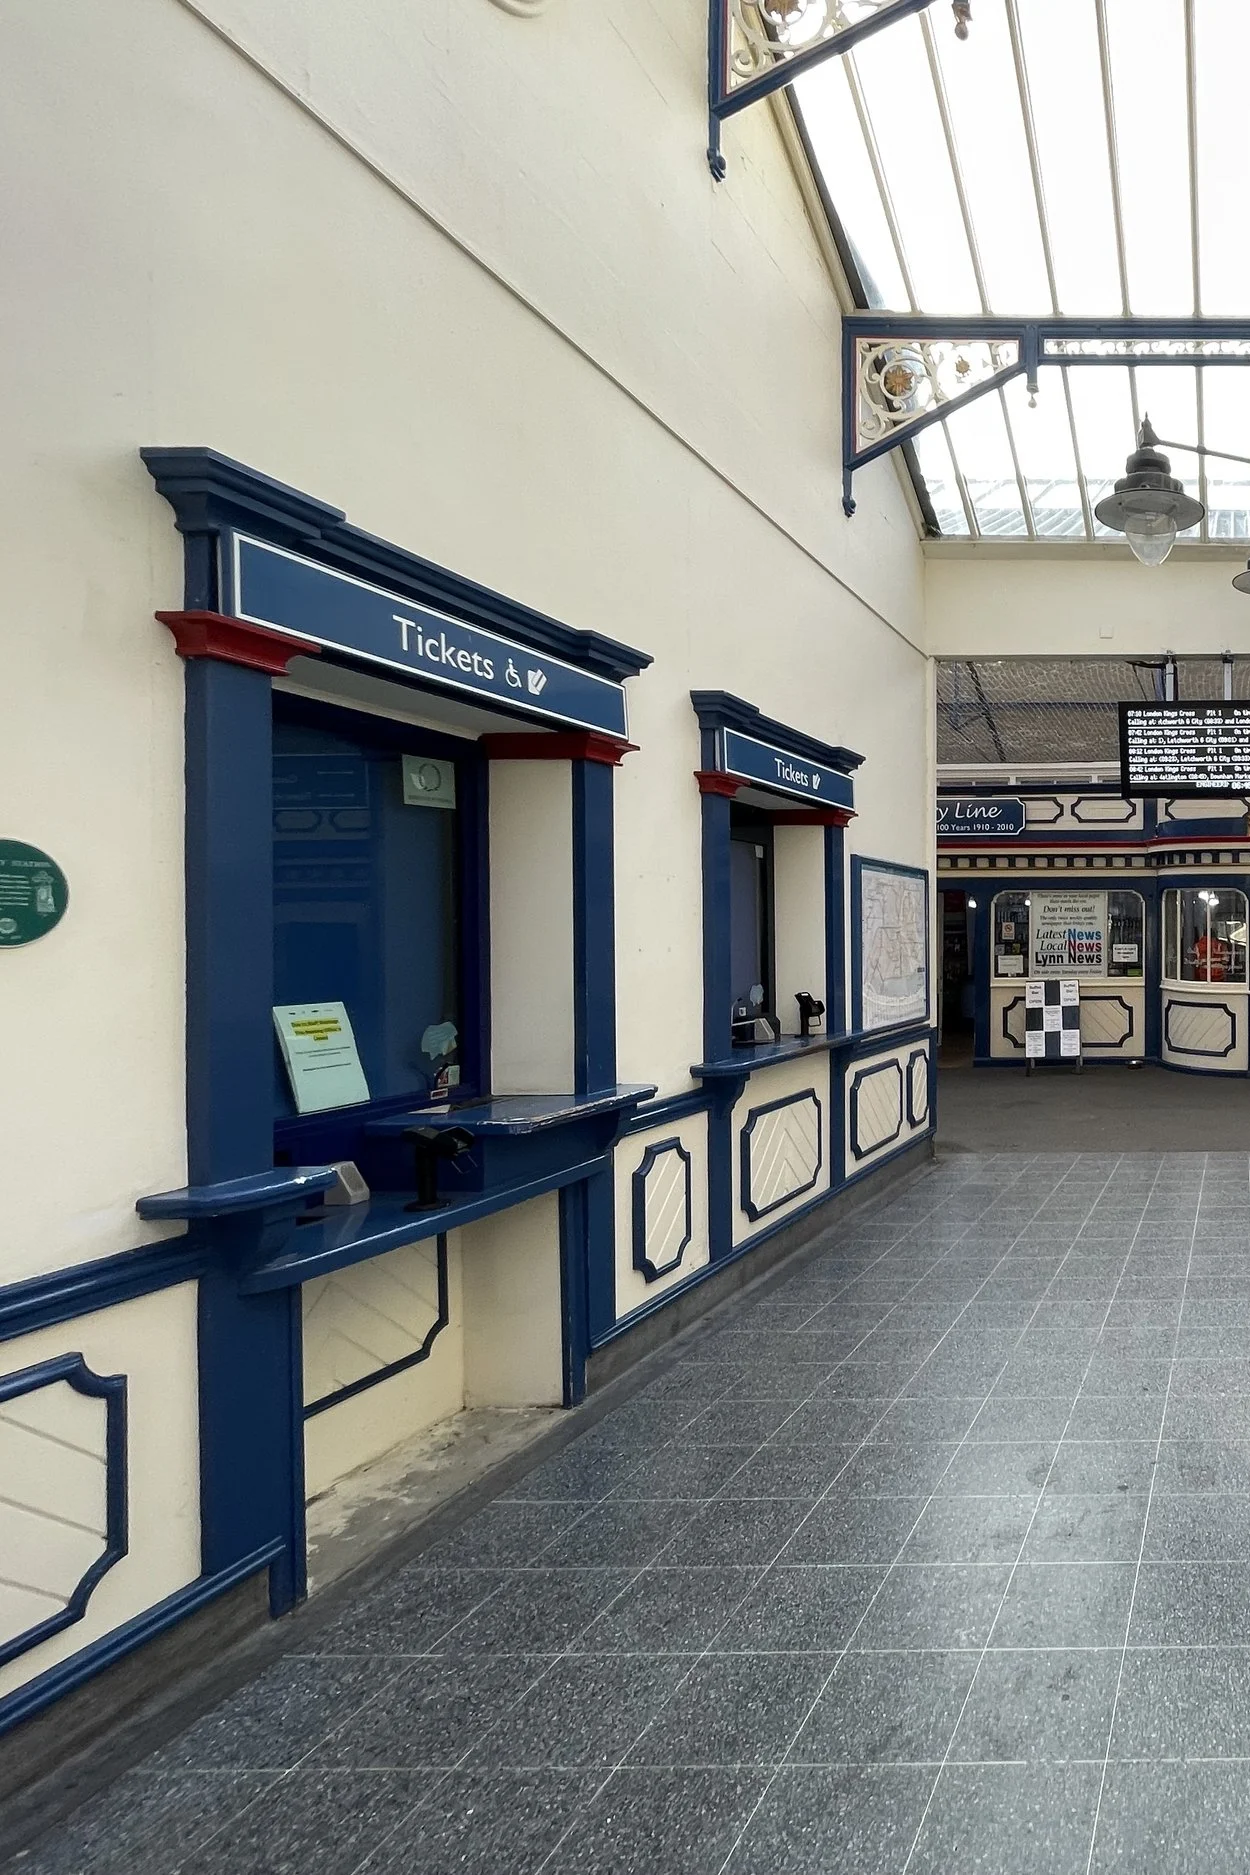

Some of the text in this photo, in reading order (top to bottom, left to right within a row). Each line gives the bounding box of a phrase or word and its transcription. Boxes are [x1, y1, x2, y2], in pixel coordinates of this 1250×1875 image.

[392, 614, 494, 680] Tickets
[774, 758, 808, 786] Tickets
[955, 802, 1002, 818] Line
[997, 823, 1014, 831] 2010
[1036, 928, 1102, 940] Latest News
[1040, 940, 1067, 950] Local
[1068, 940, 1102, 952] News
[1036, 952, 1064, 967] Lynn
[1068, 952, 1102, 964] News
